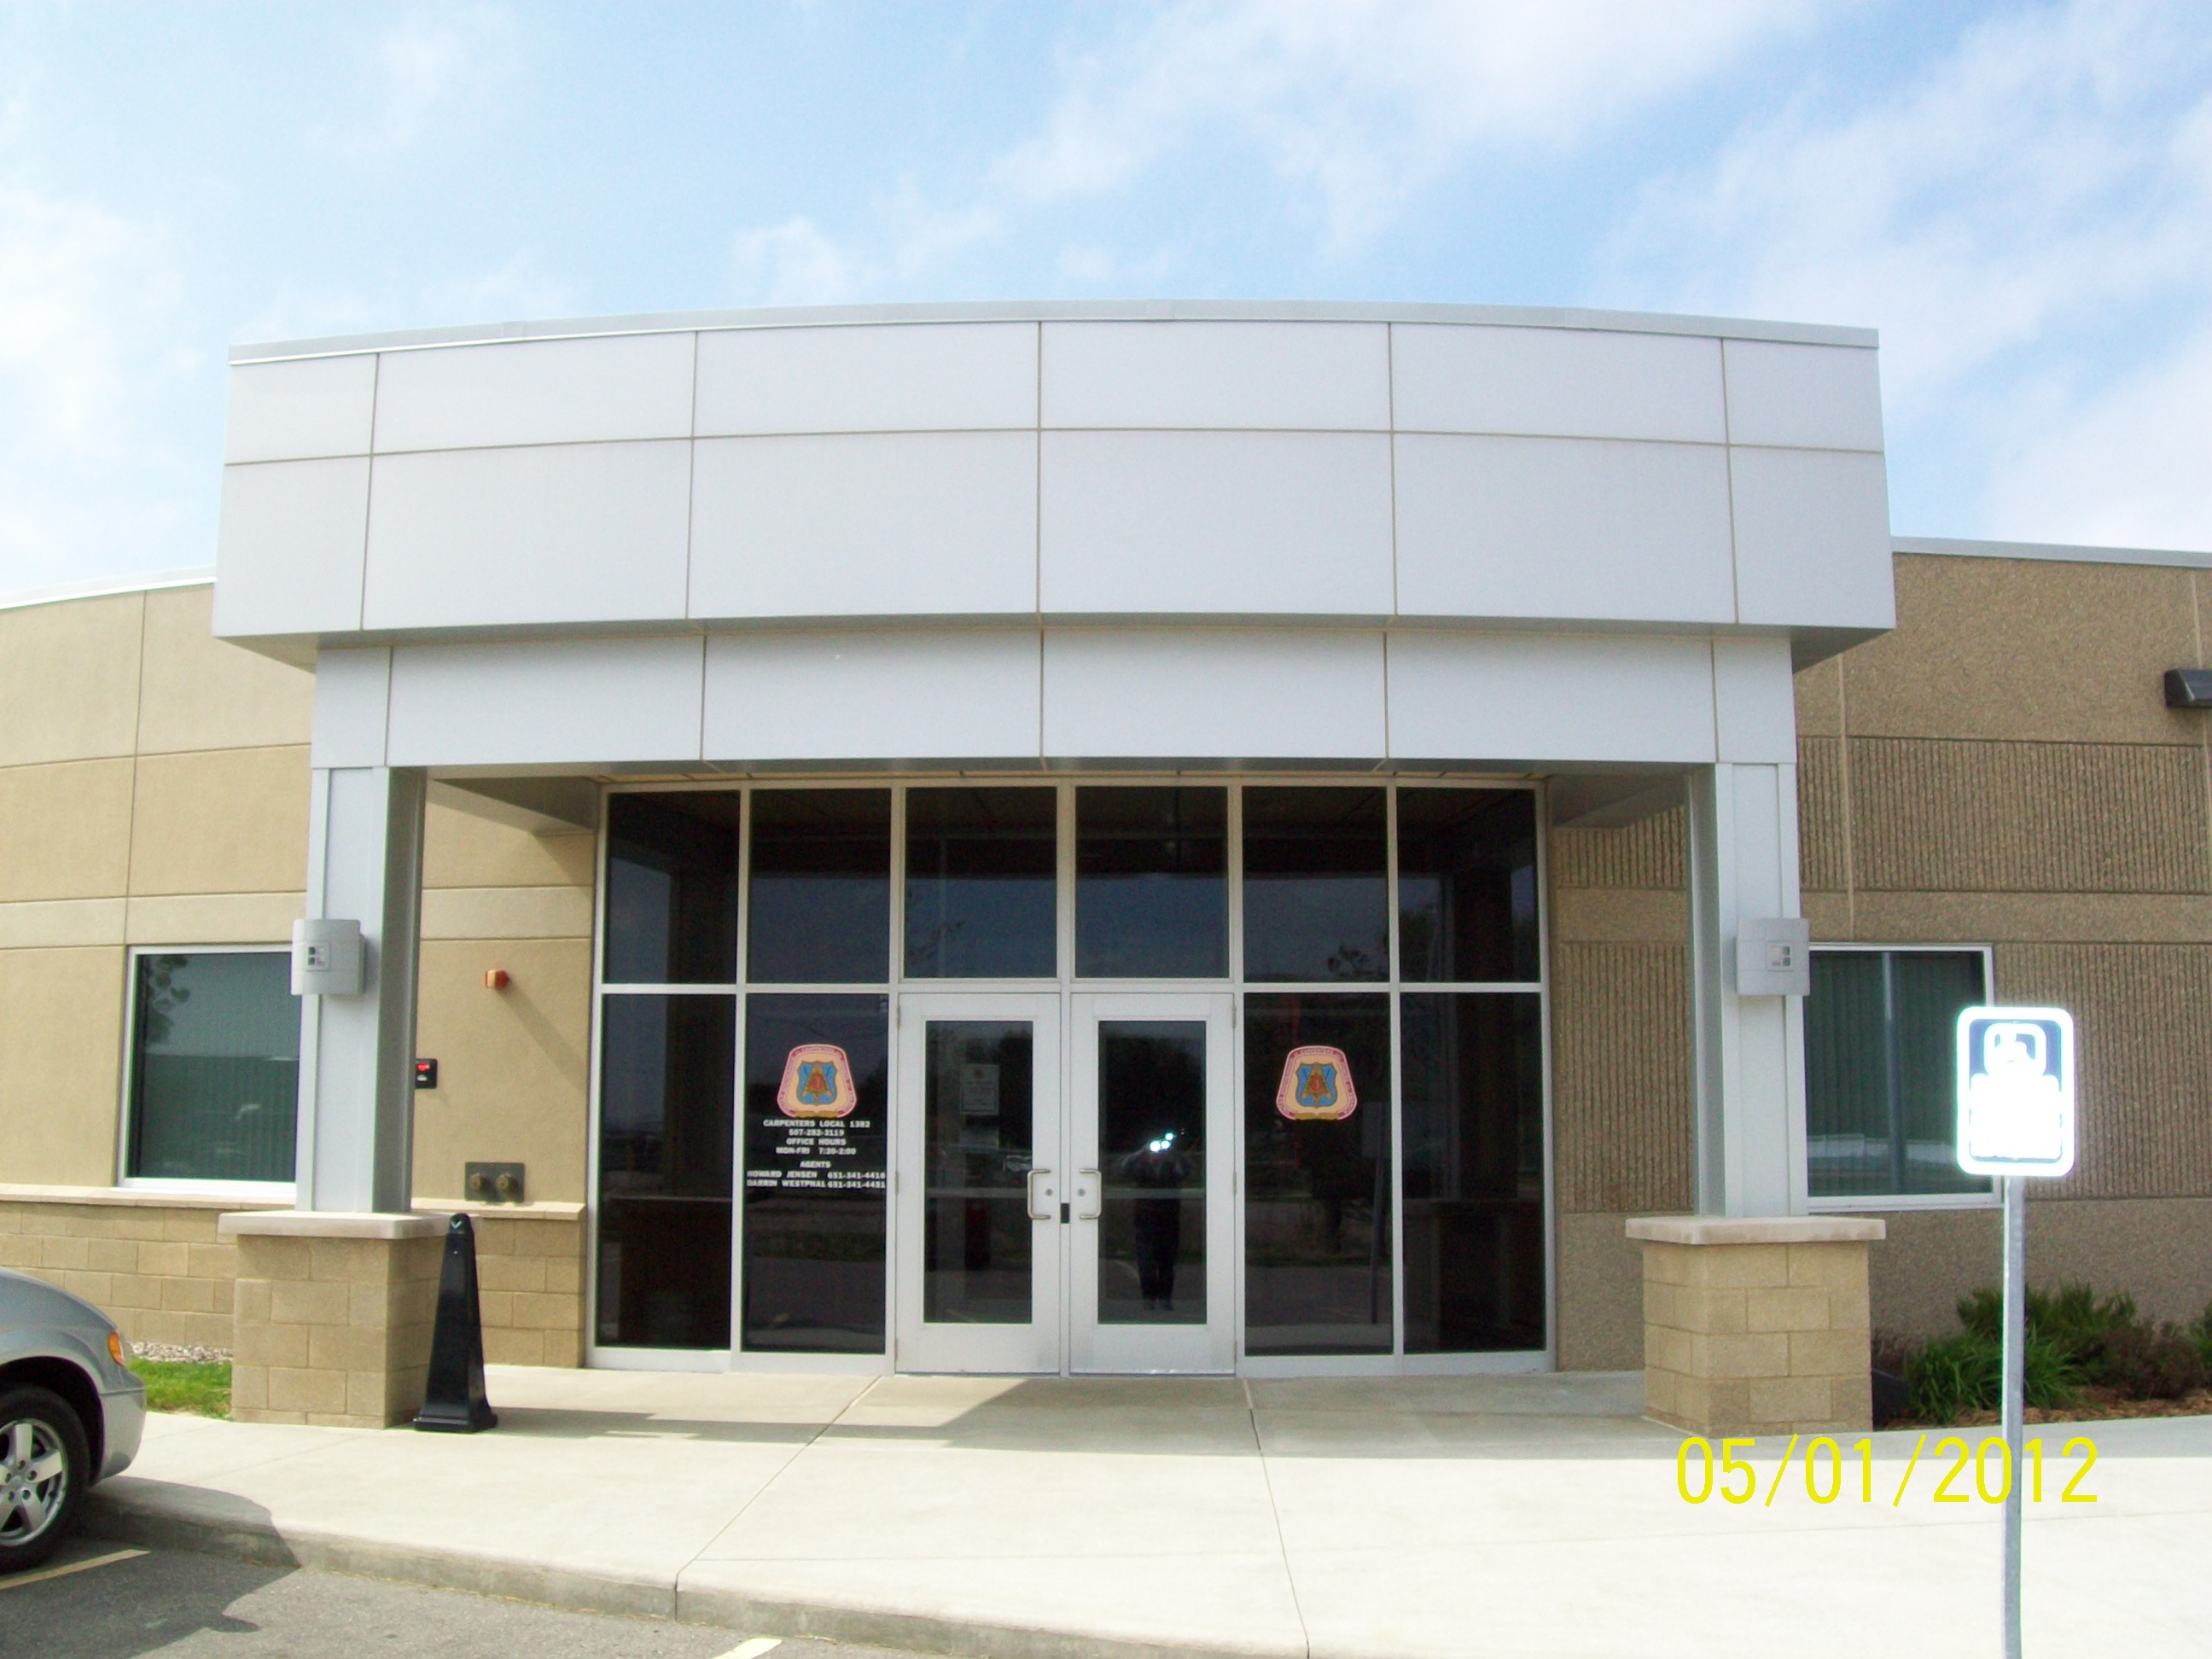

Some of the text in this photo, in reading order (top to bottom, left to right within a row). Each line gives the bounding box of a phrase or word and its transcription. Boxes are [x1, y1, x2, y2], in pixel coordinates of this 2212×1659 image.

[819, 1120, 845, 1128] LOCAL
[786, 1138, 814, 1146] OFFICE
[800, 1161, 831, 1169] AGENTS
[747, 1170, 783, 1179] HOWARD
[786, 1170, 818, 1179] JENSEN
[747, 1179, 777, 1188] DARRIN
